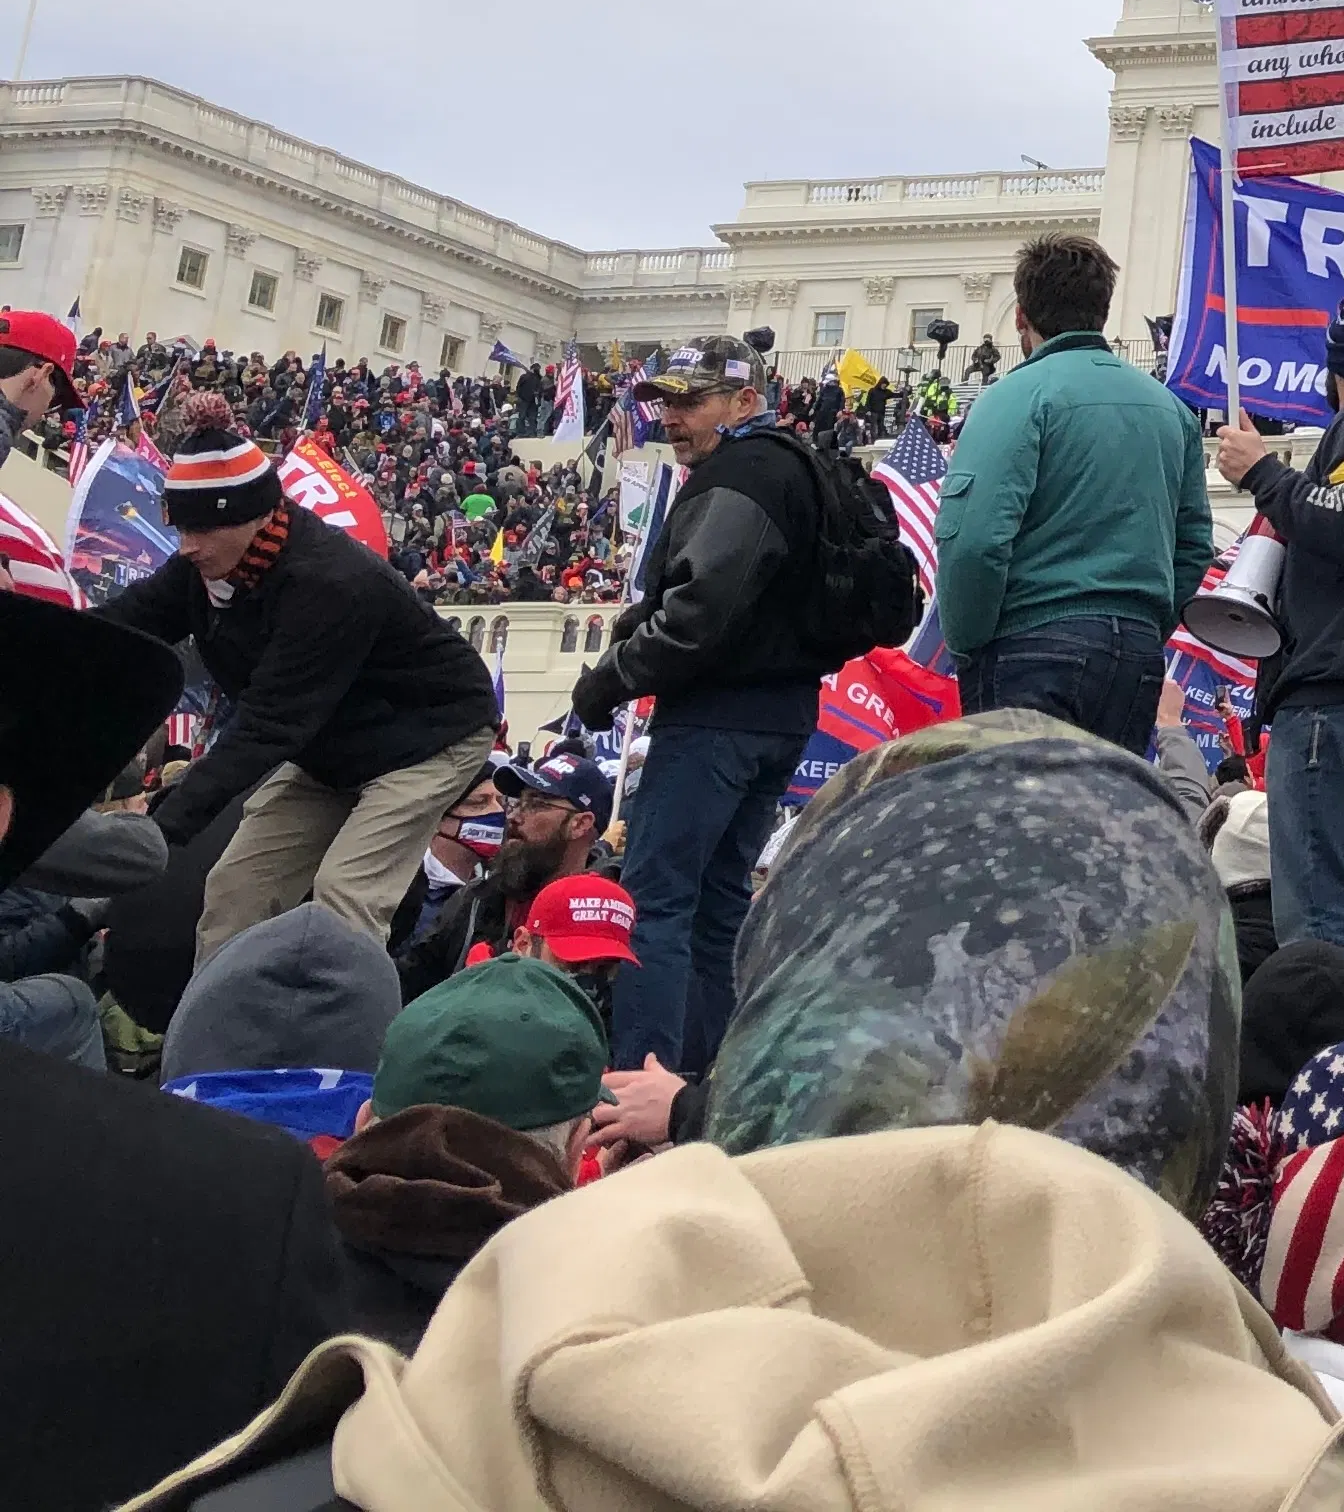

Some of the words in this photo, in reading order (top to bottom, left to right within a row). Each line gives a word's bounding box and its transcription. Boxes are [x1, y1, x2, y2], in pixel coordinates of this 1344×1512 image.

[1247, 55, 1292, 77] any
[1251, 109, 1337, 139] include
[795, 759, 843, 779] KEE
[569, 897, 601, 910] MAKE
[572, 910, 609, 922] GREAT
